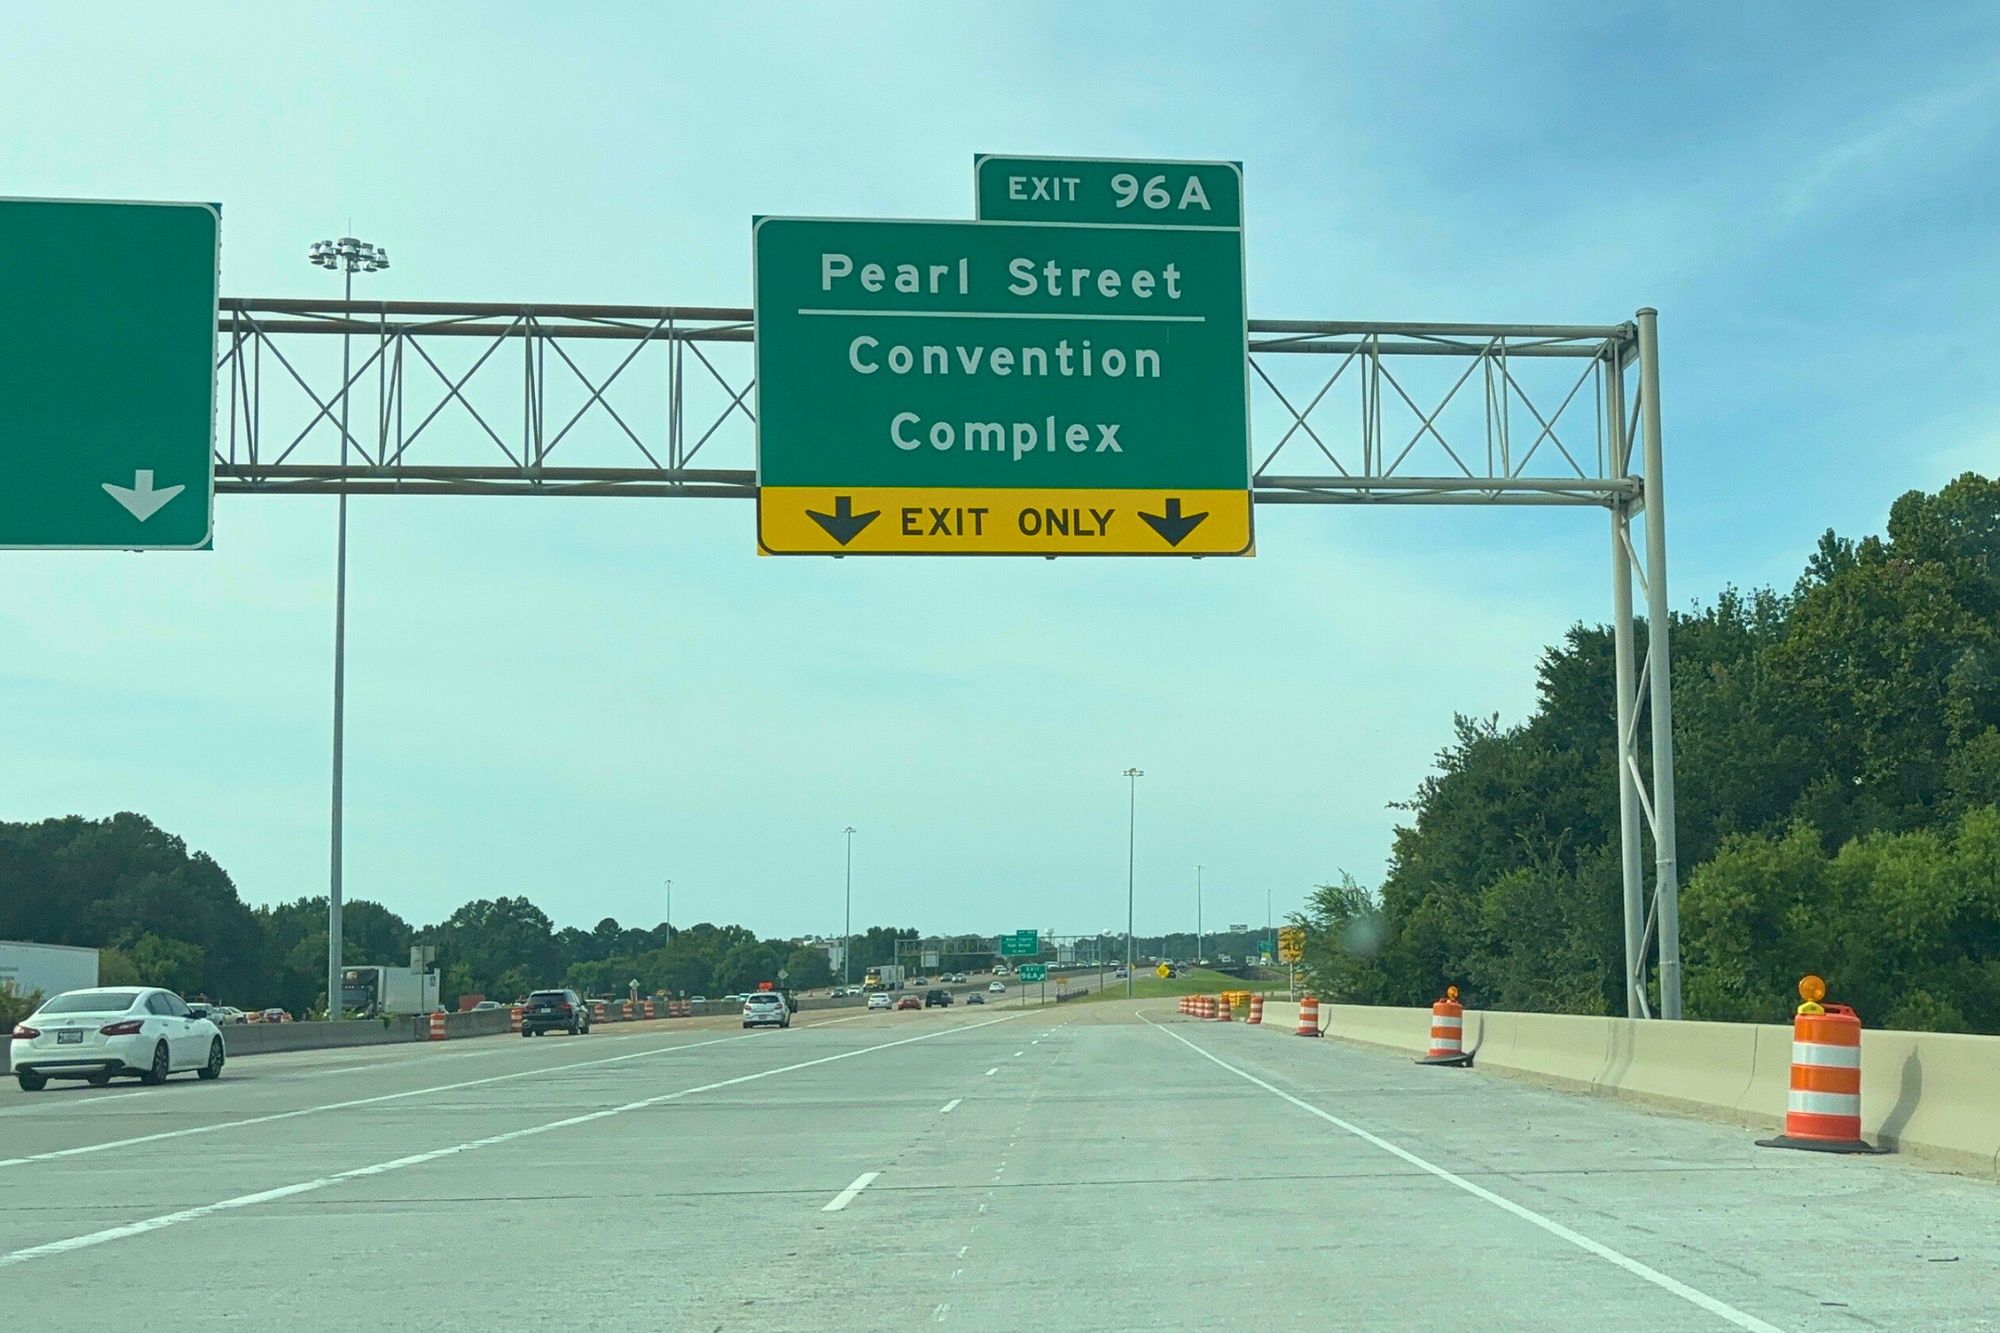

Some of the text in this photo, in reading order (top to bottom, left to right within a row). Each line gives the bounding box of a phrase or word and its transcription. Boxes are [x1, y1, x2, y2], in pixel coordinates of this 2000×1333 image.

[1009, 173, 1211, 210] EXIT 96A
[822, 253, 1181, 299] Pearl Street
[849, 335, 1160, 378] Convention
[891, 412, 1123, 461] Complex
[901, 507, 1115, 537] EXIT ONLY
